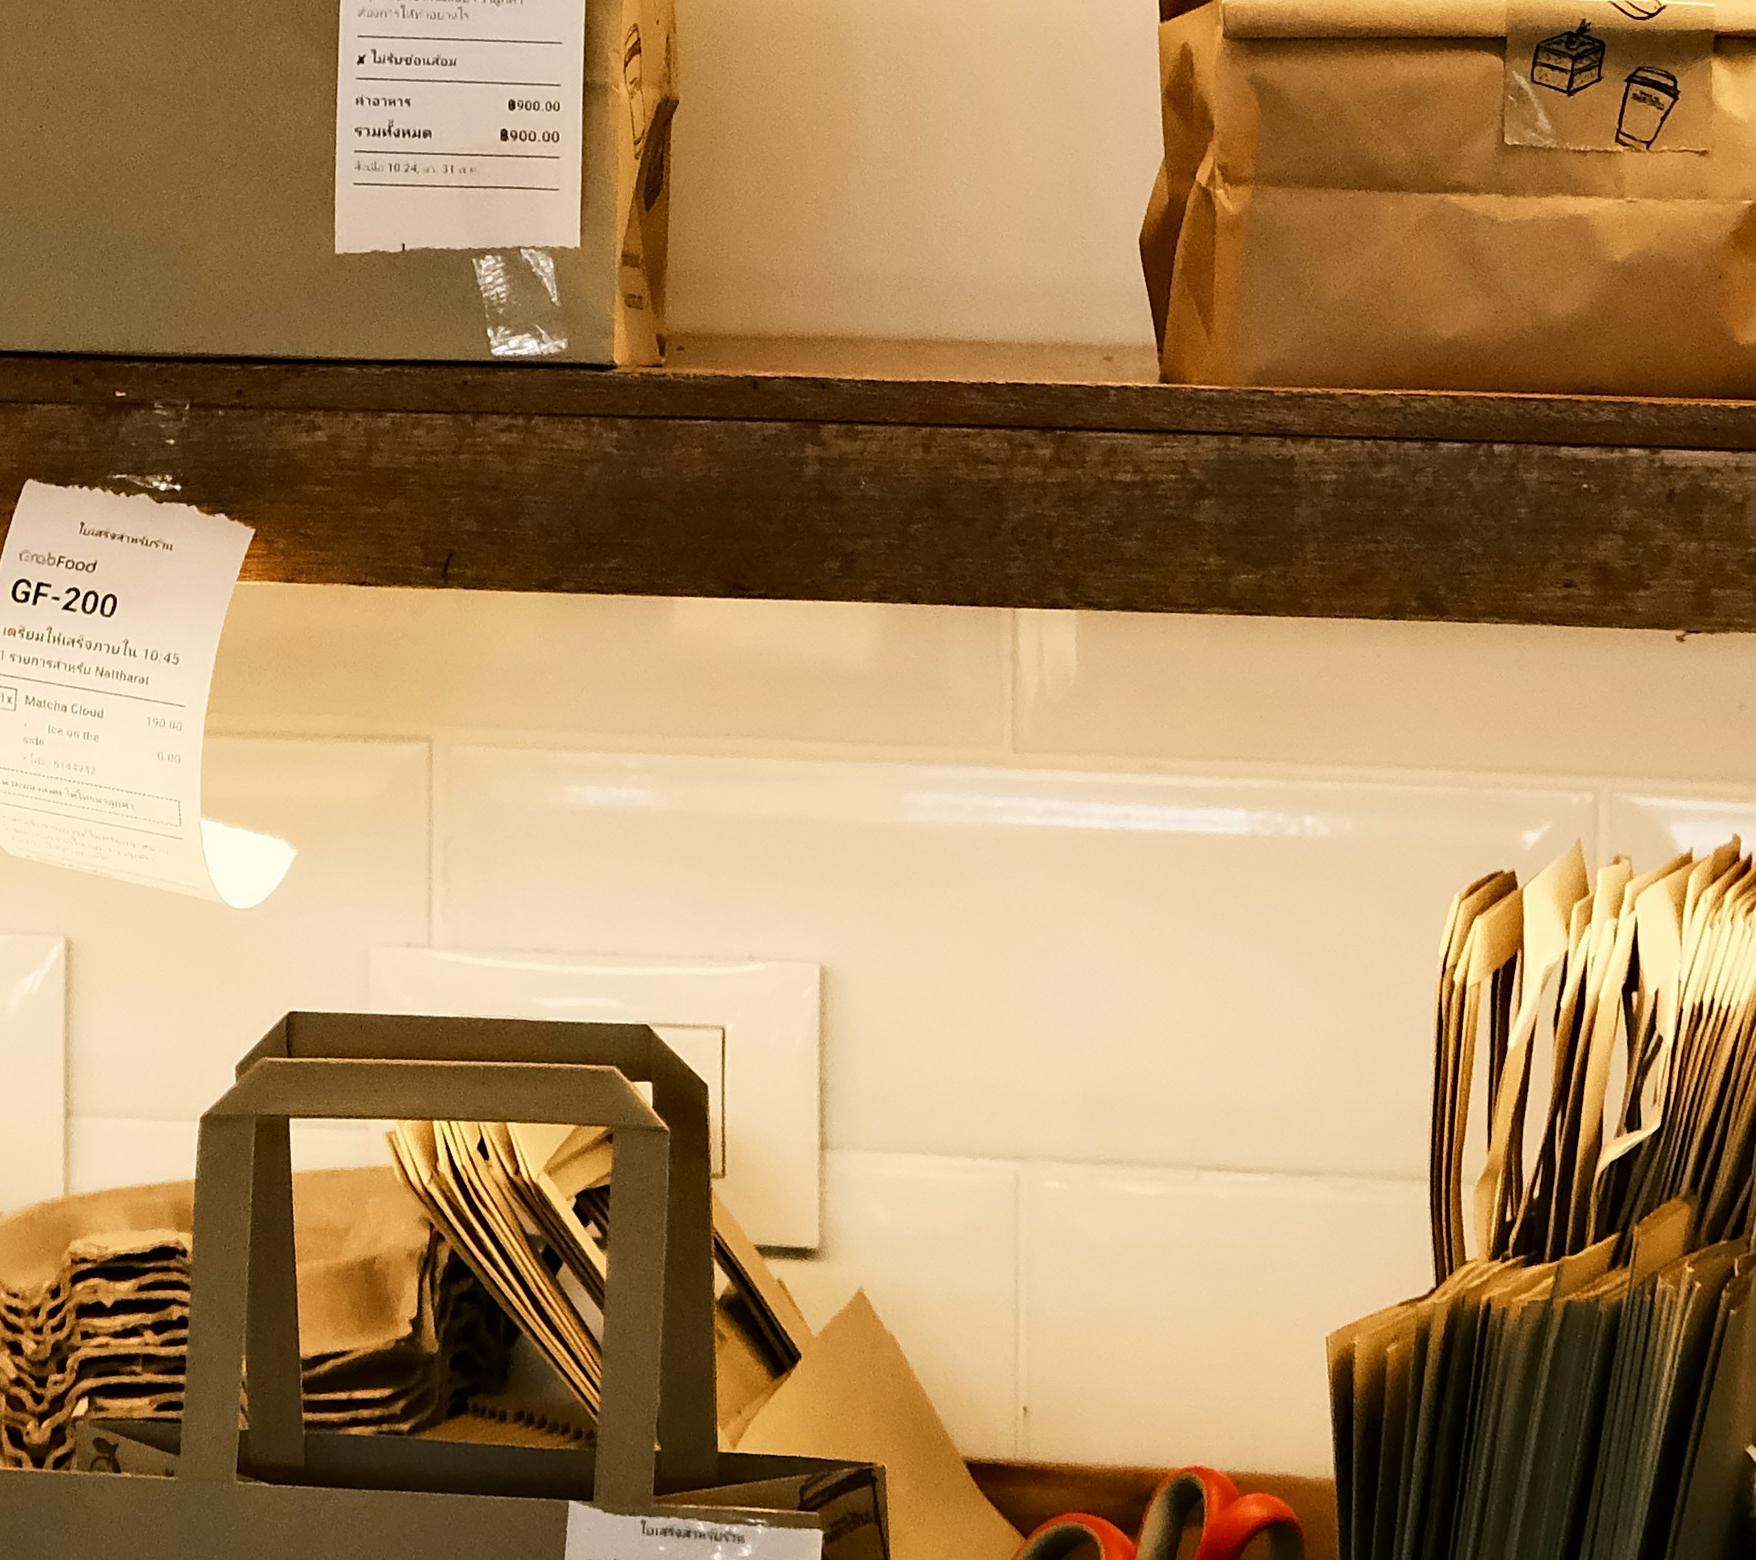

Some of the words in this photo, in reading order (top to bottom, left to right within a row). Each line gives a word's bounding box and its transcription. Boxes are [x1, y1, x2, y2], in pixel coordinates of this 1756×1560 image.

[355, 96, 412, 108] ค่าอาหาร
[508, 99, 561, 113] ฿900.00
[354, 119, 433, 140] รวมทั้งหมด
[500, 128, 561, 144] ฿900.00
[19, 549, 98, 573] GrabFood
[11, 578, 118, 618] GF-200
[143, 648, 181, 665] 10:45
[0, 694, 12, 704] 1x
[24, 694, 68, 713] Matcha
[71, 703, 105, 719] Cloud
[66, 729, 80, 739] on
